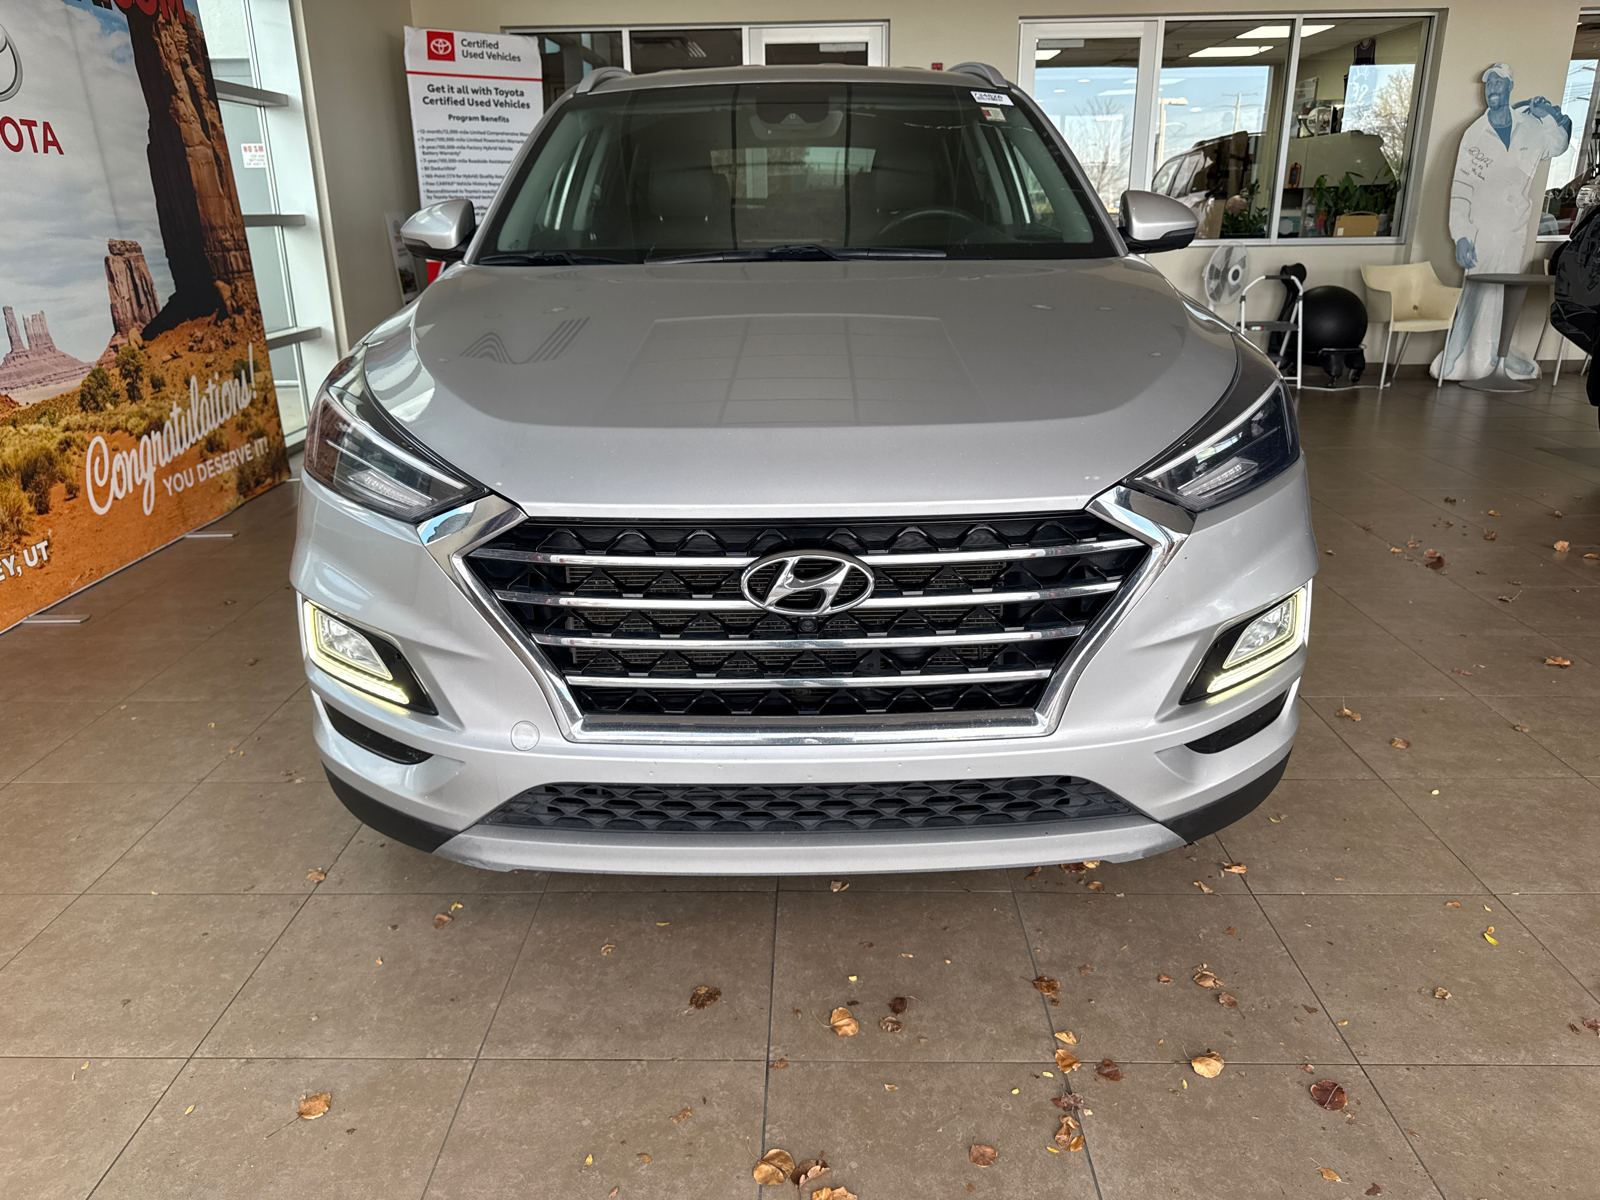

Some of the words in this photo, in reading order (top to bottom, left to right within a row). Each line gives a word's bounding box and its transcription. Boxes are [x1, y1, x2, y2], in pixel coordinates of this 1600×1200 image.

[461, 38, 499, 49] Certified
[462, 50, 484, 59] Used
[486, 51, 521, 62] Vehicles
[427, 84, 446, 94] Get
[447, 84, 455, 94] it
[456, 85, 469, 95] all
[471, 86, 492, 96] with
[493, 87, 525, 98] Toyota
[422, 96, 465, 106] Certified
[467, 98, 491, 107] Used
[492, 99, 531, 109] Vehicles
[448, 114, 479, 123] Program
[480, 115, 510, 123] Benefits
[86, 342, 257, 516] Congratulations!
[162, 468, 194, 496] YOU
[196, 444, 253, 482] DESERVE
[253, 436, 270, 458] IT!
[23, 540, 48, 567] UT
